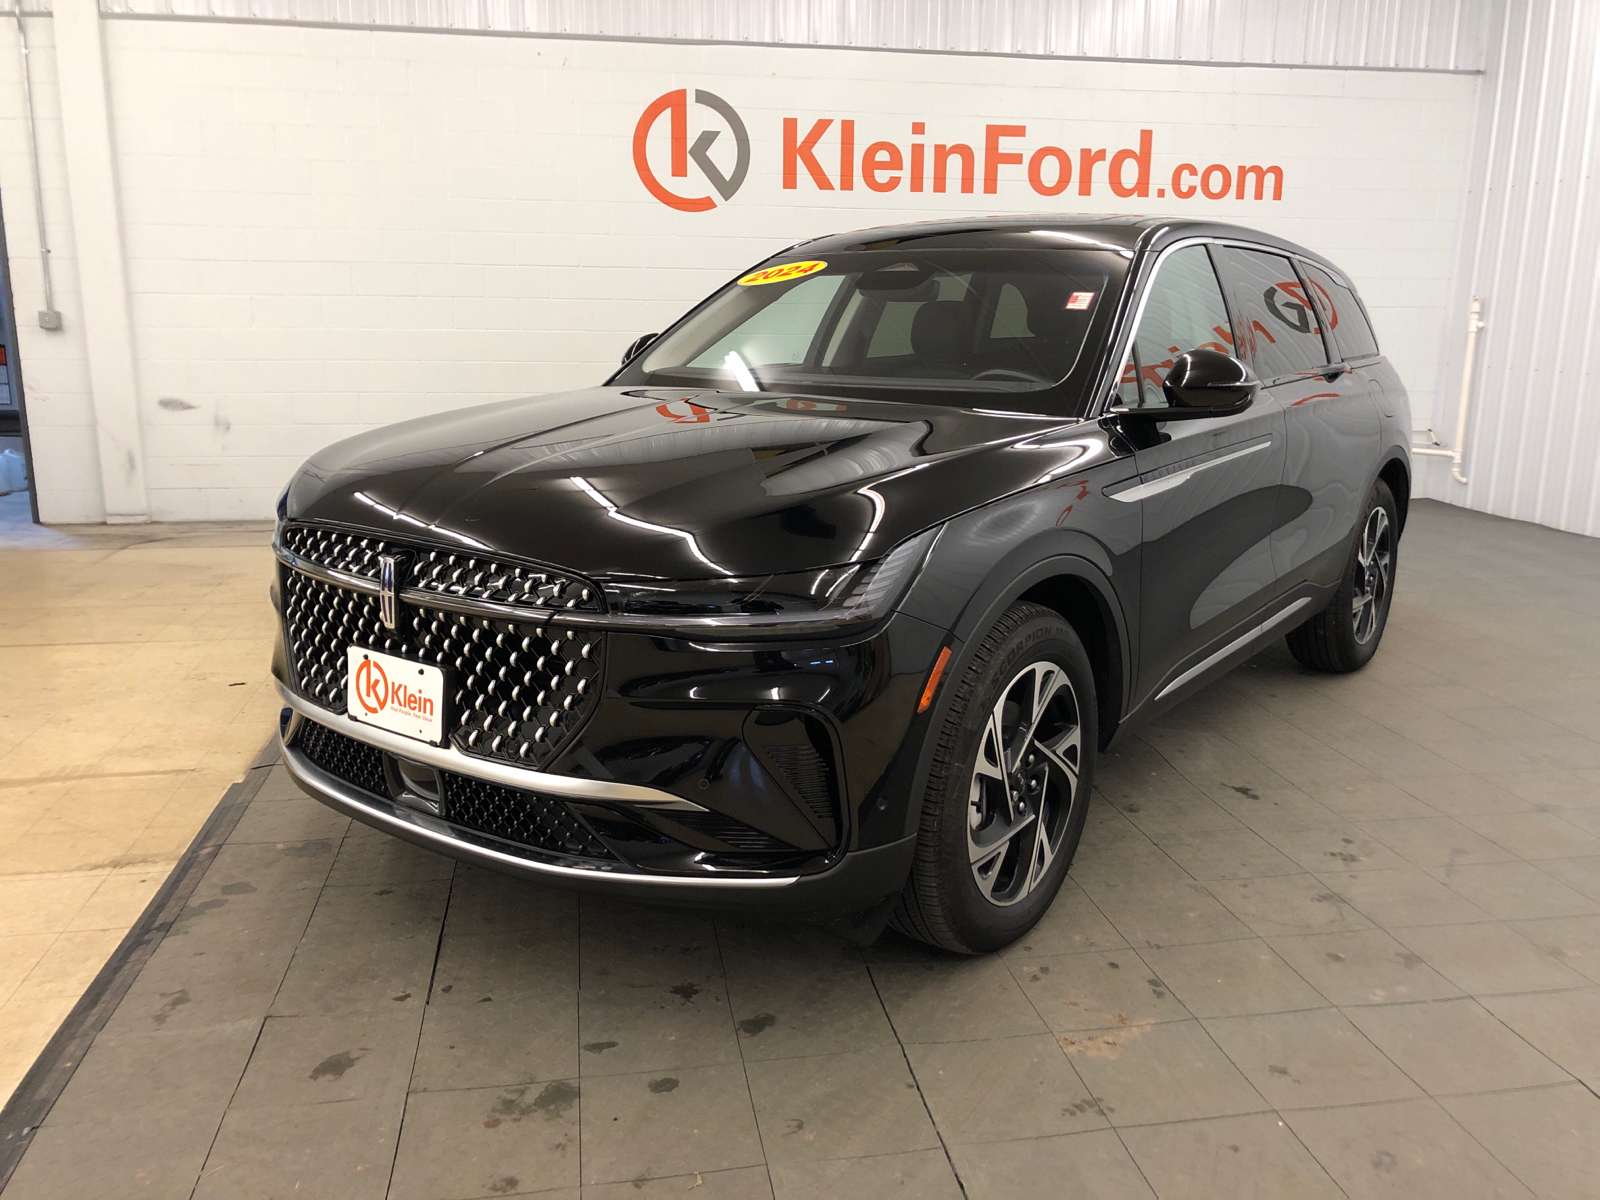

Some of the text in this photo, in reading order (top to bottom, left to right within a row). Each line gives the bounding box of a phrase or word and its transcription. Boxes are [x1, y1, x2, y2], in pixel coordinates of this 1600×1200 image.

[781, 117, 1284, 201] KleinFord.com
[743, 263, 822, 283] 2024
[391, 681, 434, 716] Klein
